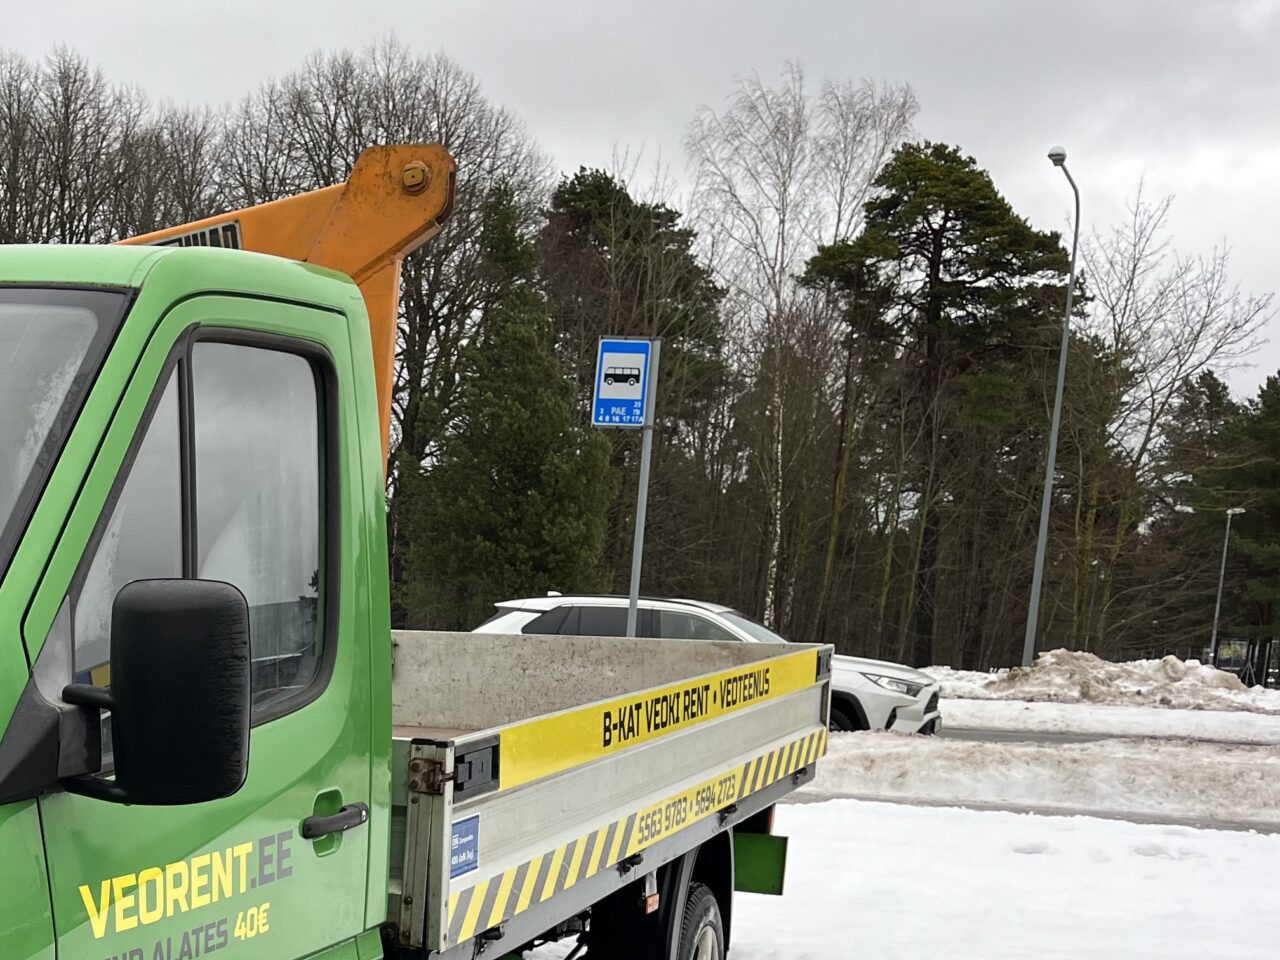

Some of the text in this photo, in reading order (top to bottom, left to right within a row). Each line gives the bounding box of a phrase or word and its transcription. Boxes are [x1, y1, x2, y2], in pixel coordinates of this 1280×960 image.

[611, 406, 626, 415] PAE
[603, 668, 770, 748] B-KAT VEOKI RENT VEOTEENUS
[638, 774, 736, 845] 5563 9783 5694 2723
[78, 829, 294, 940] VEORENT.EE
[233, 902, 271, 941] 40€
